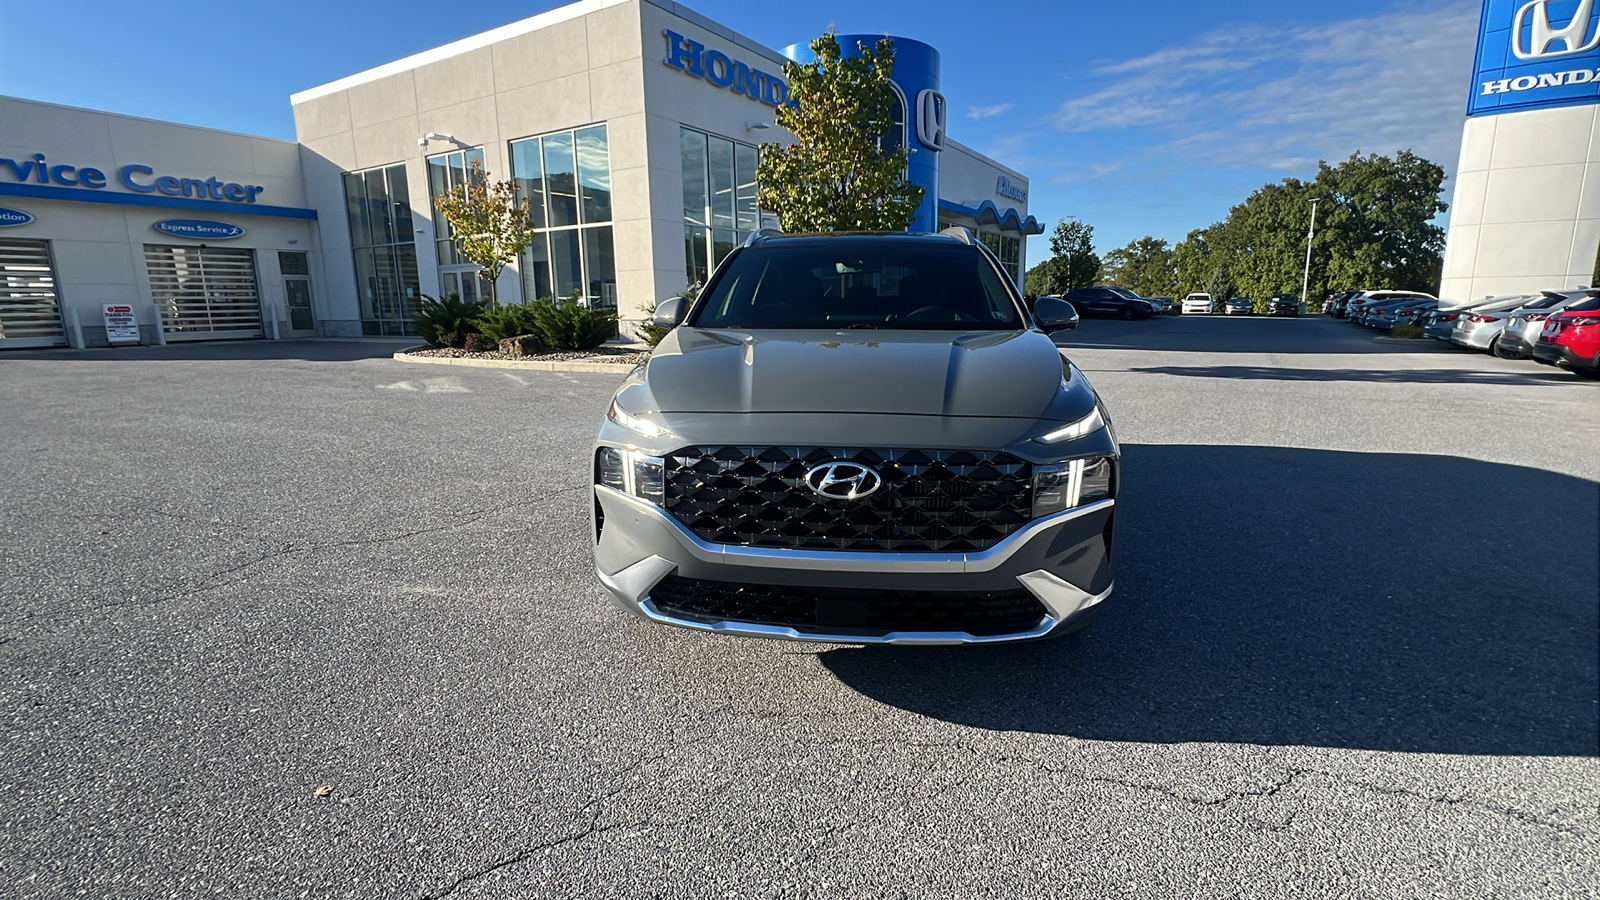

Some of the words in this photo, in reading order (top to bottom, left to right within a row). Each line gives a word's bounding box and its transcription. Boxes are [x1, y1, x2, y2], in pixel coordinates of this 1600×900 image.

[663, 28, 800, 109] HOND
[0, 152, 107, 189] vice
[118, 164, 264, 203] Center
[161, 222, 195, 232] Express
[196, 225, 228, 234] Service
